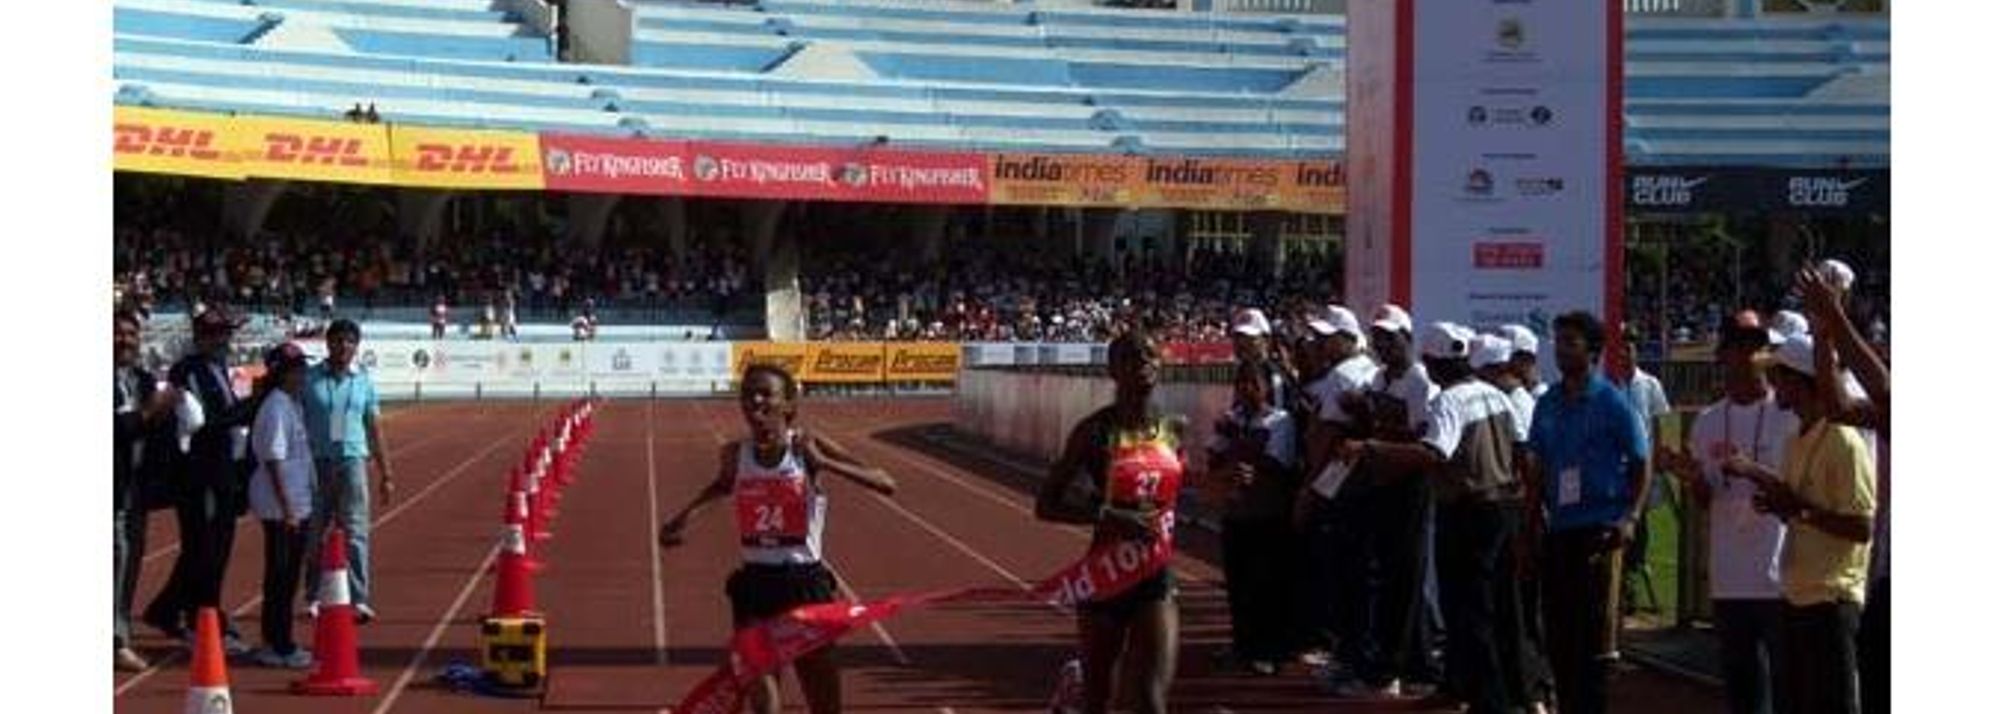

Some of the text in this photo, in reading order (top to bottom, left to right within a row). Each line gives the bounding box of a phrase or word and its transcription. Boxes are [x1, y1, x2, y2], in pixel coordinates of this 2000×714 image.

[113, 125, 218, 159] DHL
[263, 133, 369, 166] DHL
[414, 143, 521, 173] DHL
[1634, 189, 1691, 205] CLUB
[1789, 189, 1848, 206] CLUB
[1136, 470, 1162, 496] 27
[755, 505, 783, 532] 24
